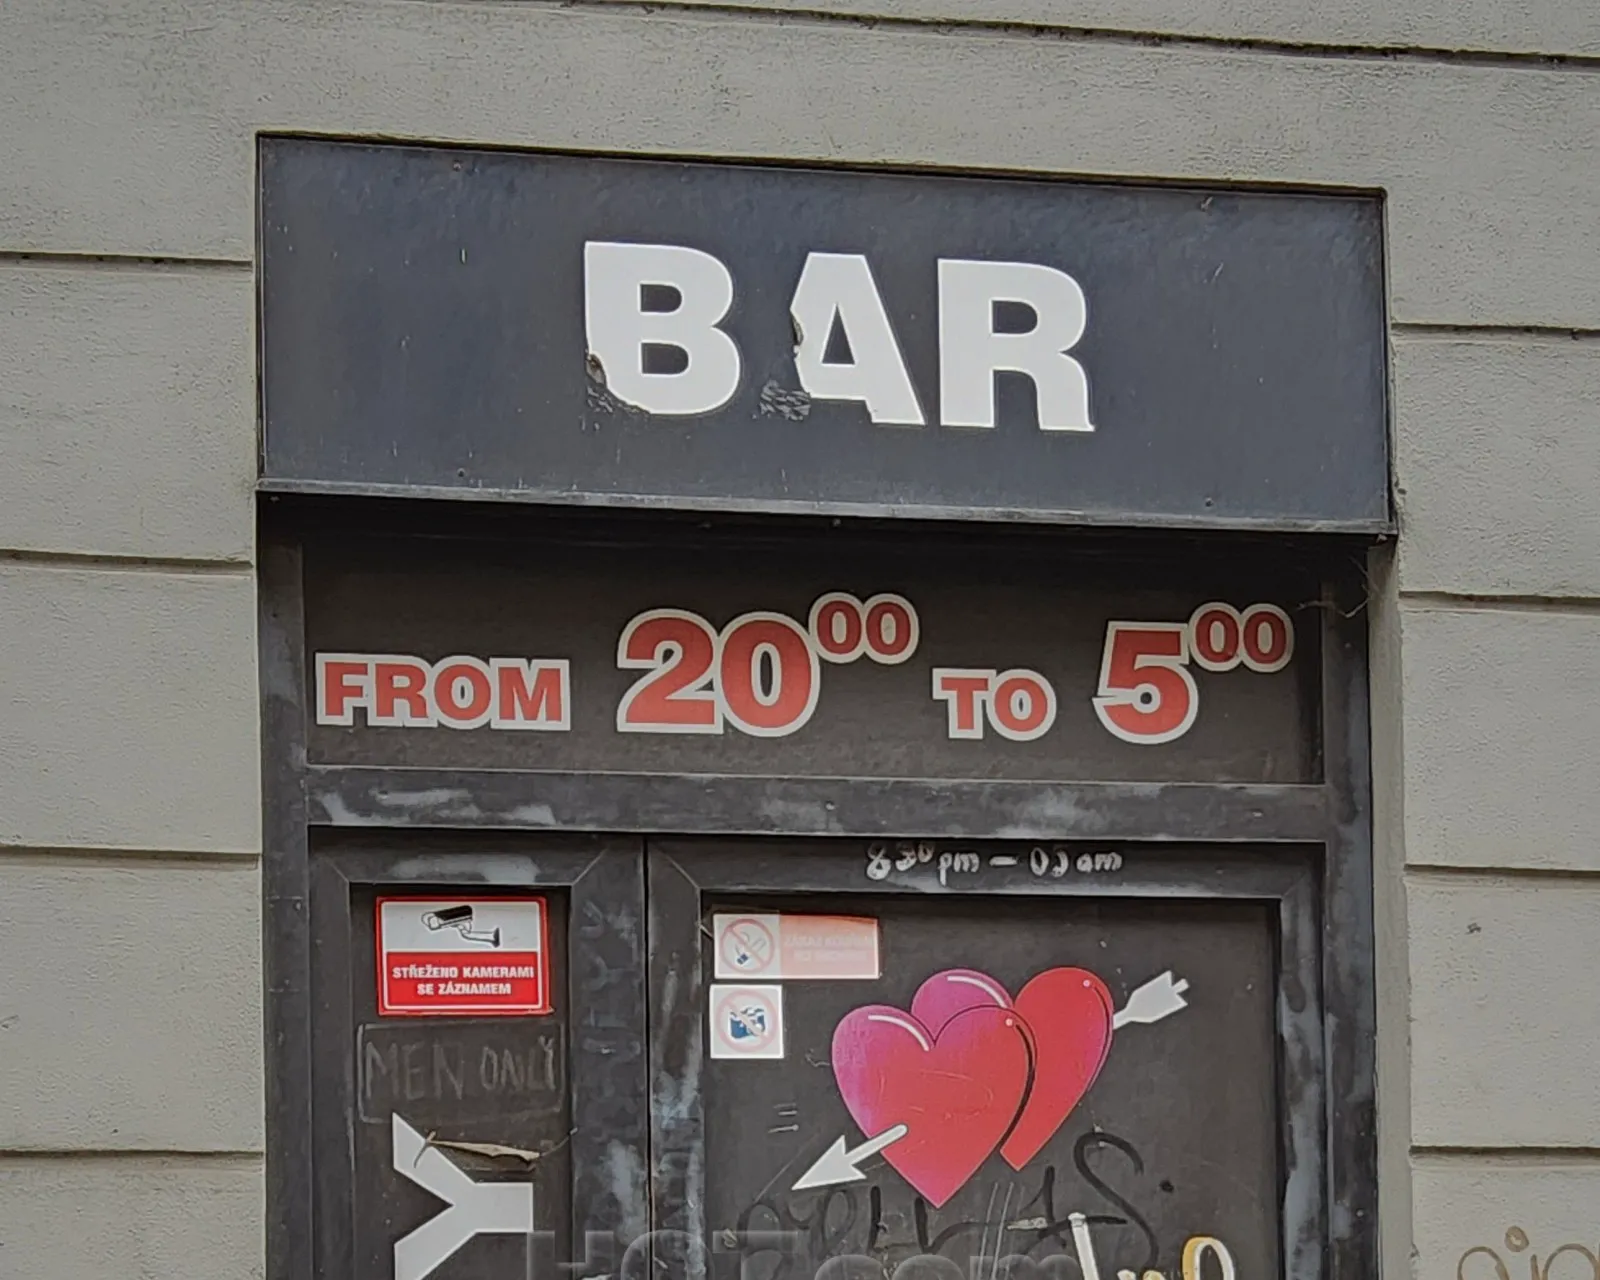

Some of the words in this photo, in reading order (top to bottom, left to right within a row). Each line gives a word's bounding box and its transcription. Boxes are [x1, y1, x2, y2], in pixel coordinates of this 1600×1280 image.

[584, 241, 1095, 431] BAR
[315, 652, 570, 731] FROM
[932, 668, 1057, 741] TO
[938, 851, 980, 886] pm
[1076, 851, 1123, 874] am
[392, 963, 459, 979] STŘEŽENO
[462, 965, 535, 979] KAMERAMI
[416, 983, 435, 995] SE
[438, 980, 512, 995] ZÁZNAMEM
[364, 1038, 464, 1101] MEN
[479, 1034, 557, 1091] ONLY
